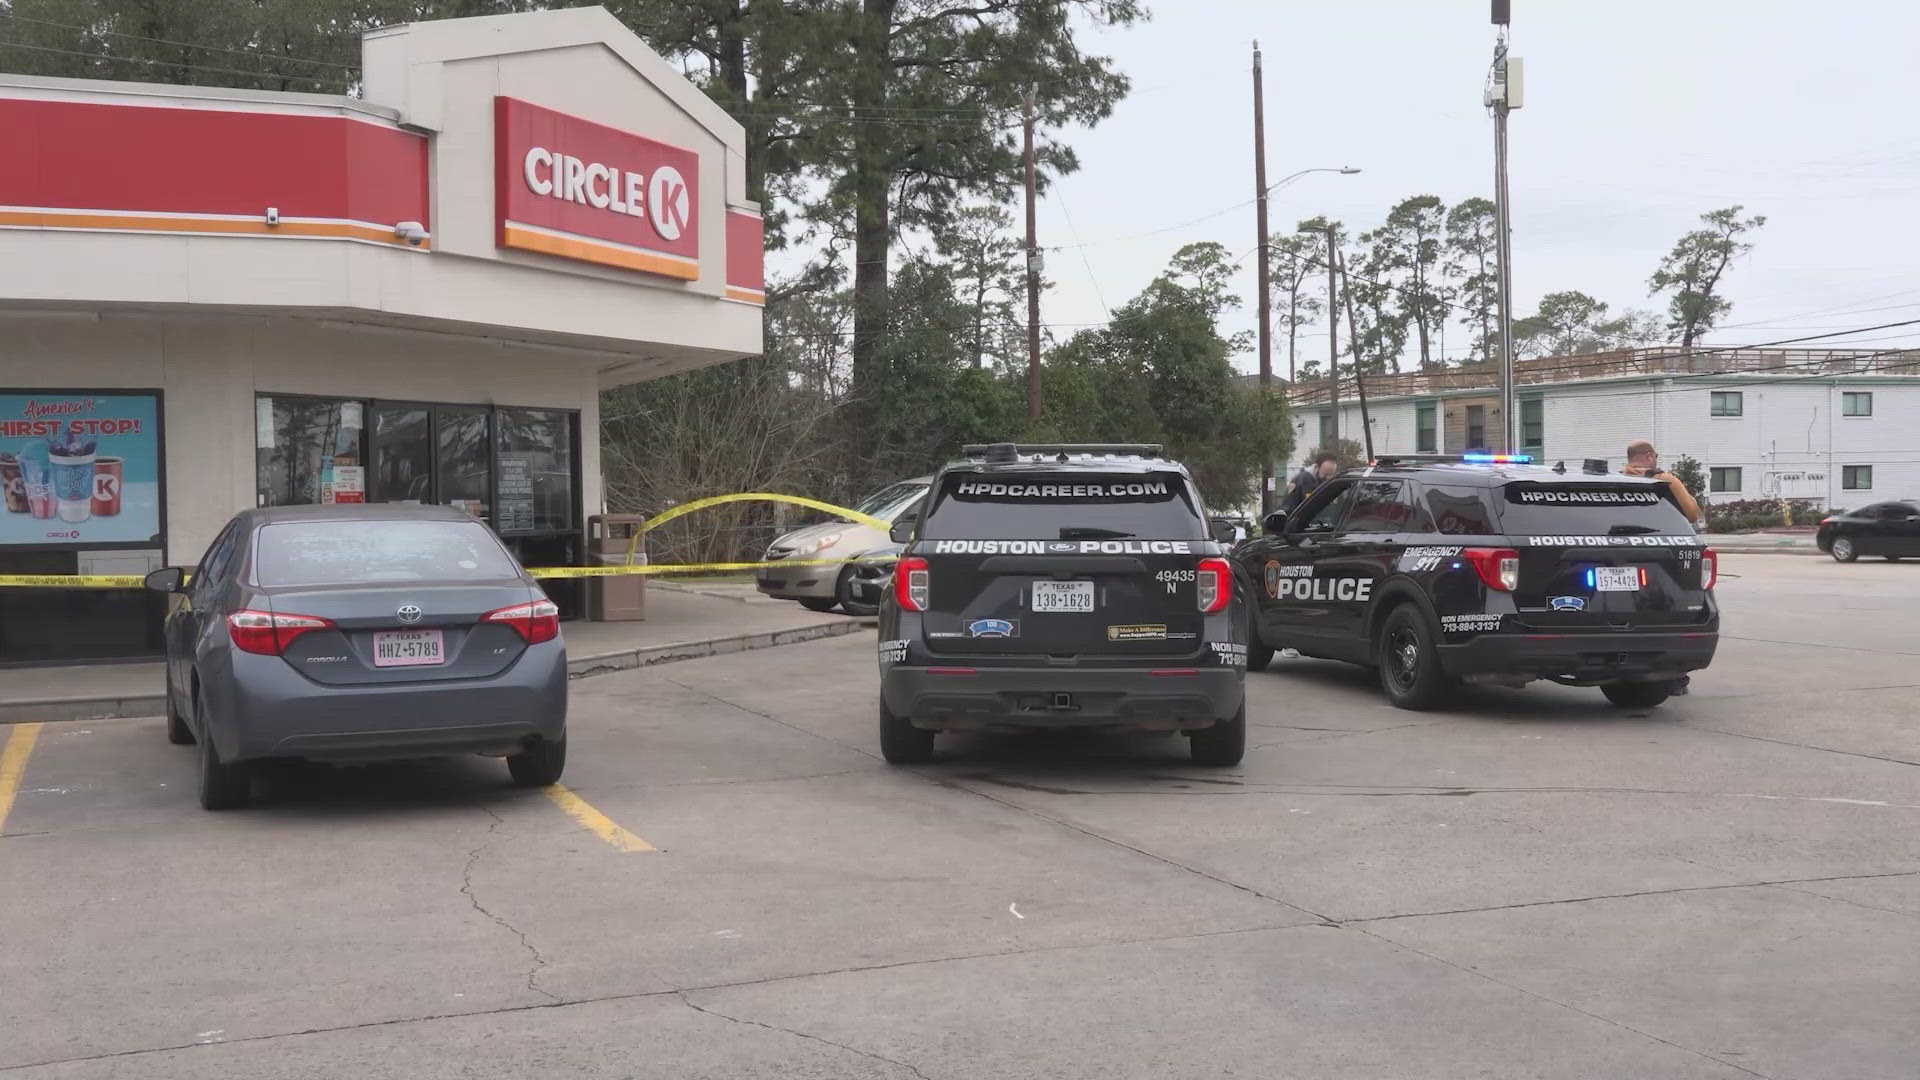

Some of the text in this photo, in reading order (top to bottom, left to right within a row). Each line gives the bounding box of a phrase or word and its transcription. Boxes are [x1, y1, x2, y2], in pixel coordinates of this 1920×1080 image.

[525, 147, 689, 240] CIRCLE K
[24, 399, 96, 418] America's
[70, 419, 140, 435] STOP!
[97, 477, 118, 500] K
[958, 483, 1168, 497] HPDCAREER.COM
[1520, 491, 1659, 502] HPDCAREER.COM
[935, 540, 1045, 554] HOUSTON
[1080, 541, 1191, 554] POLICE
[1529, 537, 1609, 546] HOUSTON
[1630, 537, 1696, 546] POLICE
[1403, 547, 1462, 557] EMERGENCY
[1679, 551, 1700, 560] 51819
[1412, 557, 1442, 571] 911
[1684, 561, 1690, 569] N
[1156, 570, 1195, 582] 49435
[1280, 565, 1314, 577] HOUSTON
[1167, 582, 1177, 594] N
[1277, 578, 1373, 601] POLICE
[1441, 613, 1503, 623] NON EMERGENCY
[1443, 621, 1501, 632] 713-884-3131
[1211, 642, 1232, 652] NON
